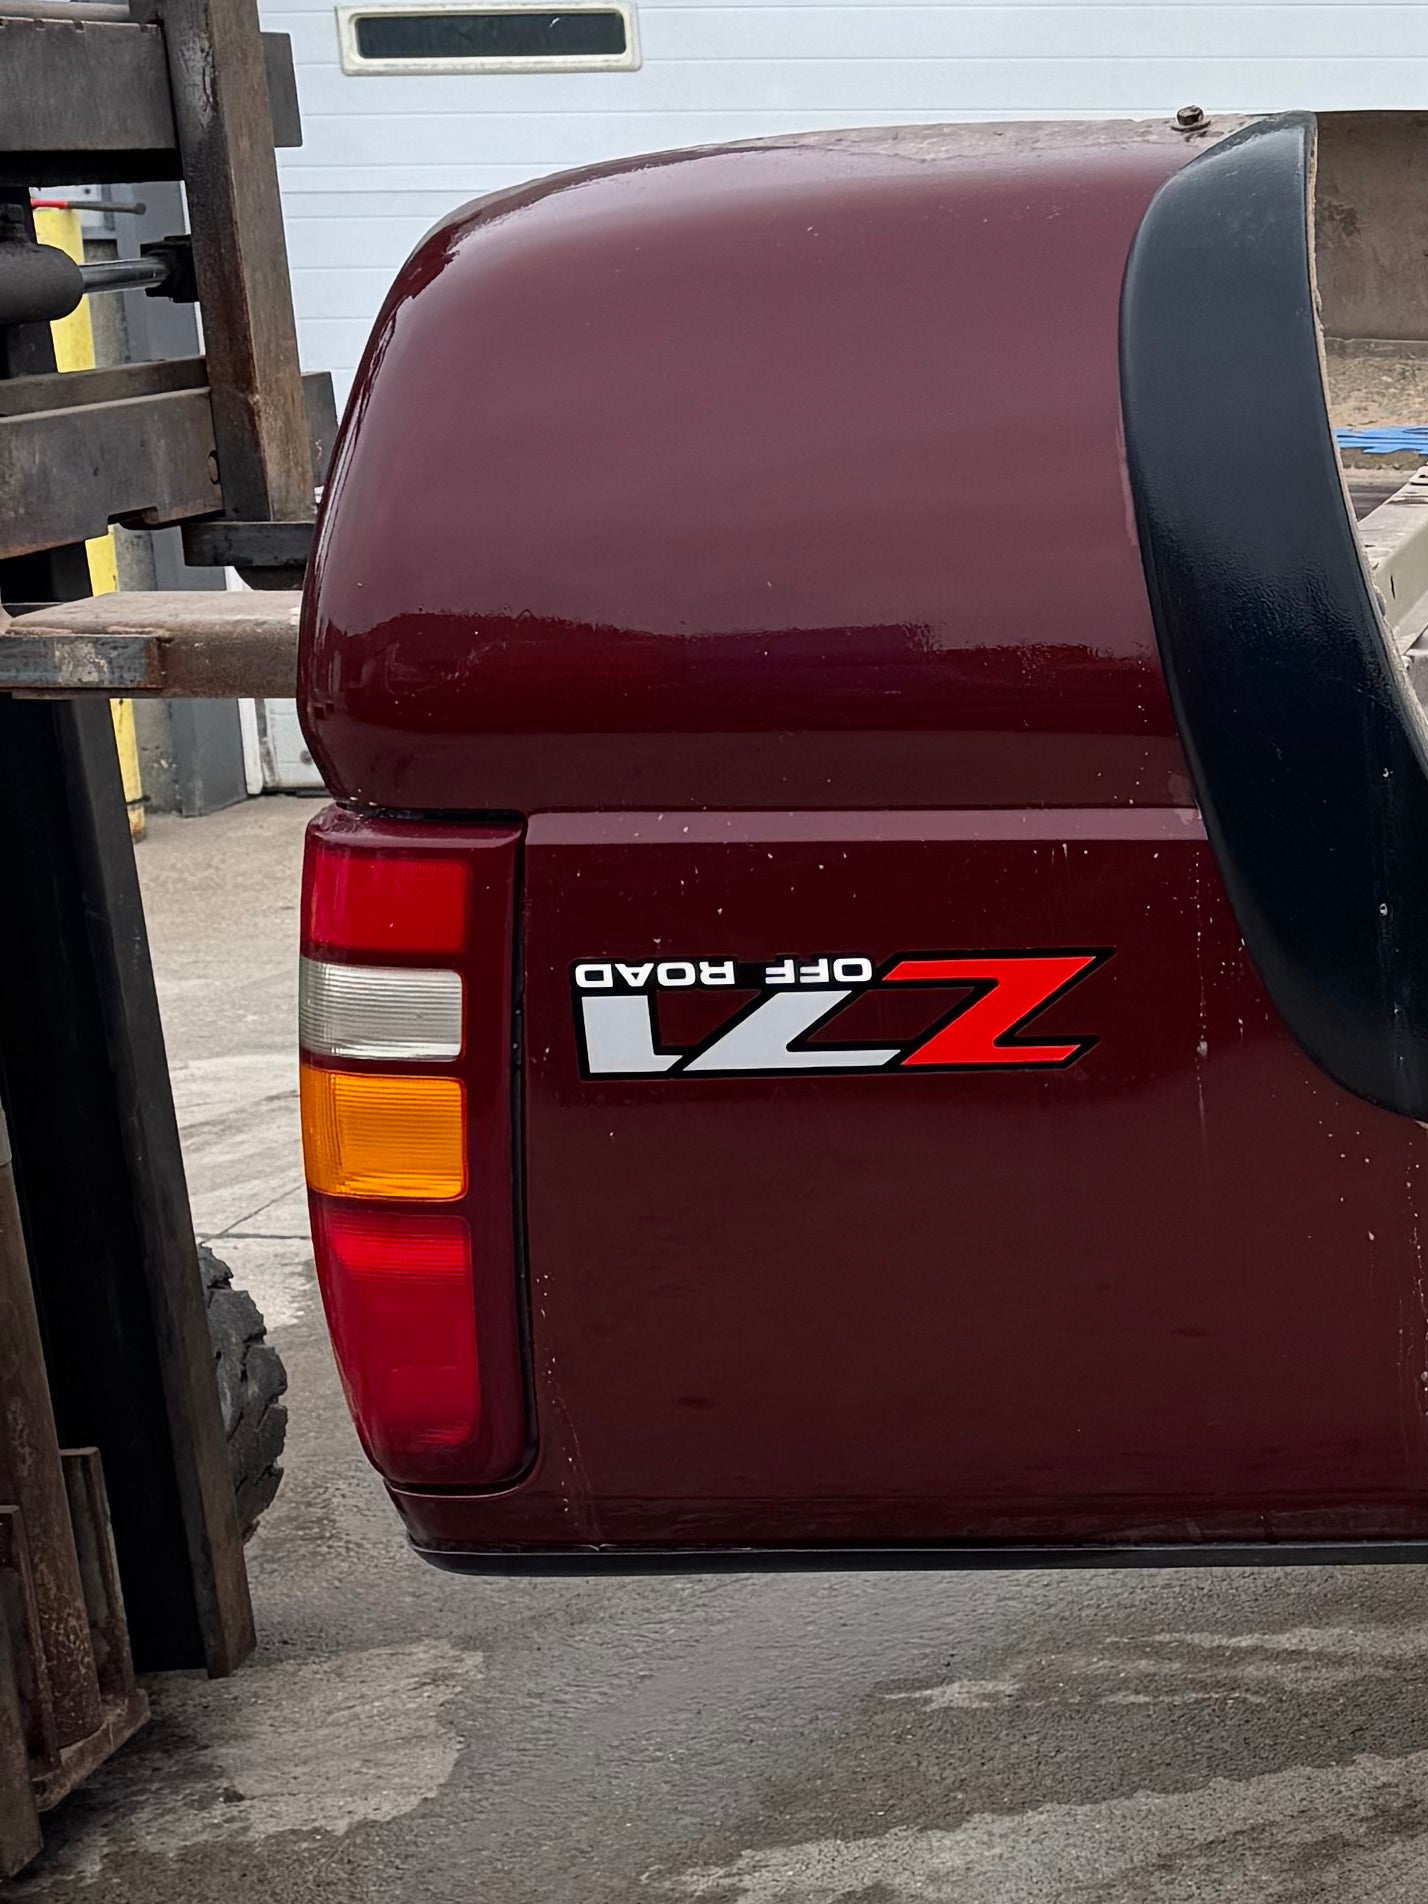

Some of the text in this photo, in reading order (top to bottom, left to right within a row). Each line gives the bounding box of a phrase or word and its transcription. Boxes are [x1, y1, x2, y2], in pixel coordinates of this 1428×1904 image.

[574, 956, 874, 989] OFF ROAD
[580, 955, 1097, 1073] Z71
